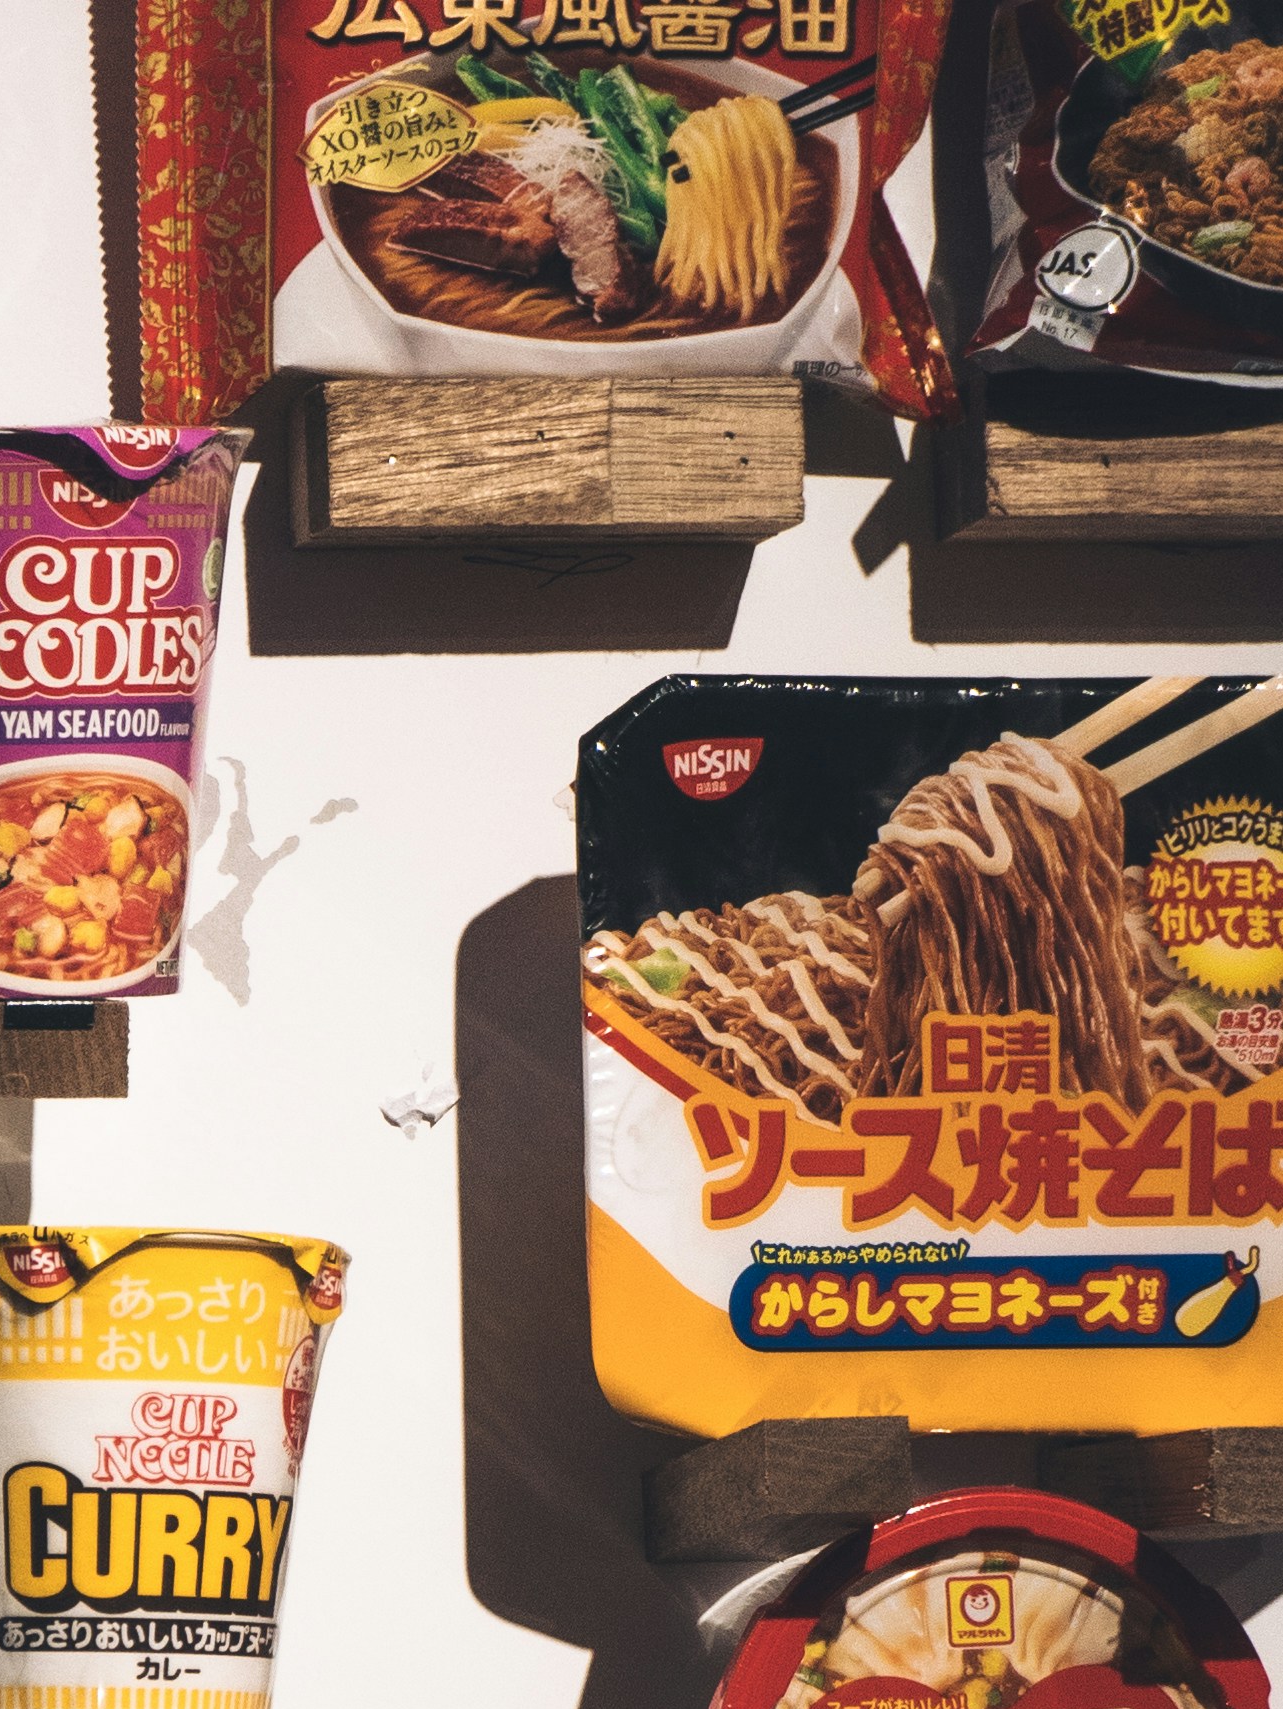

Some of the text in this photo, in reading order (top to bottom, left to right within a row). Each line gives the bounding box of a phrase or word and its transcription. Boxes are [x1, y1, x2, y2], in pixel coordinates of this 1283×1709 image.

[1041, 250, 1098, 278] JAS
[5, 545, 179, 614] CUP
[0, 709, 54, 740] YAM
[57, 708, 159, 739] SEAFOOD
[672, 741, 752, 781] NISSIN
[929, 1018, 1056, 1095] 日清
[108, 1274, 266, 1324] あっさり
[758, 1274, 1136, 1330] からしマヨネーズ
[96, 1326, 267, 1375] おいしい
[130, 1391, 238, 1438] CUP
[5, 1463, 292, 1606] CURRY
[136, 1657, 202, 1681] カレー
